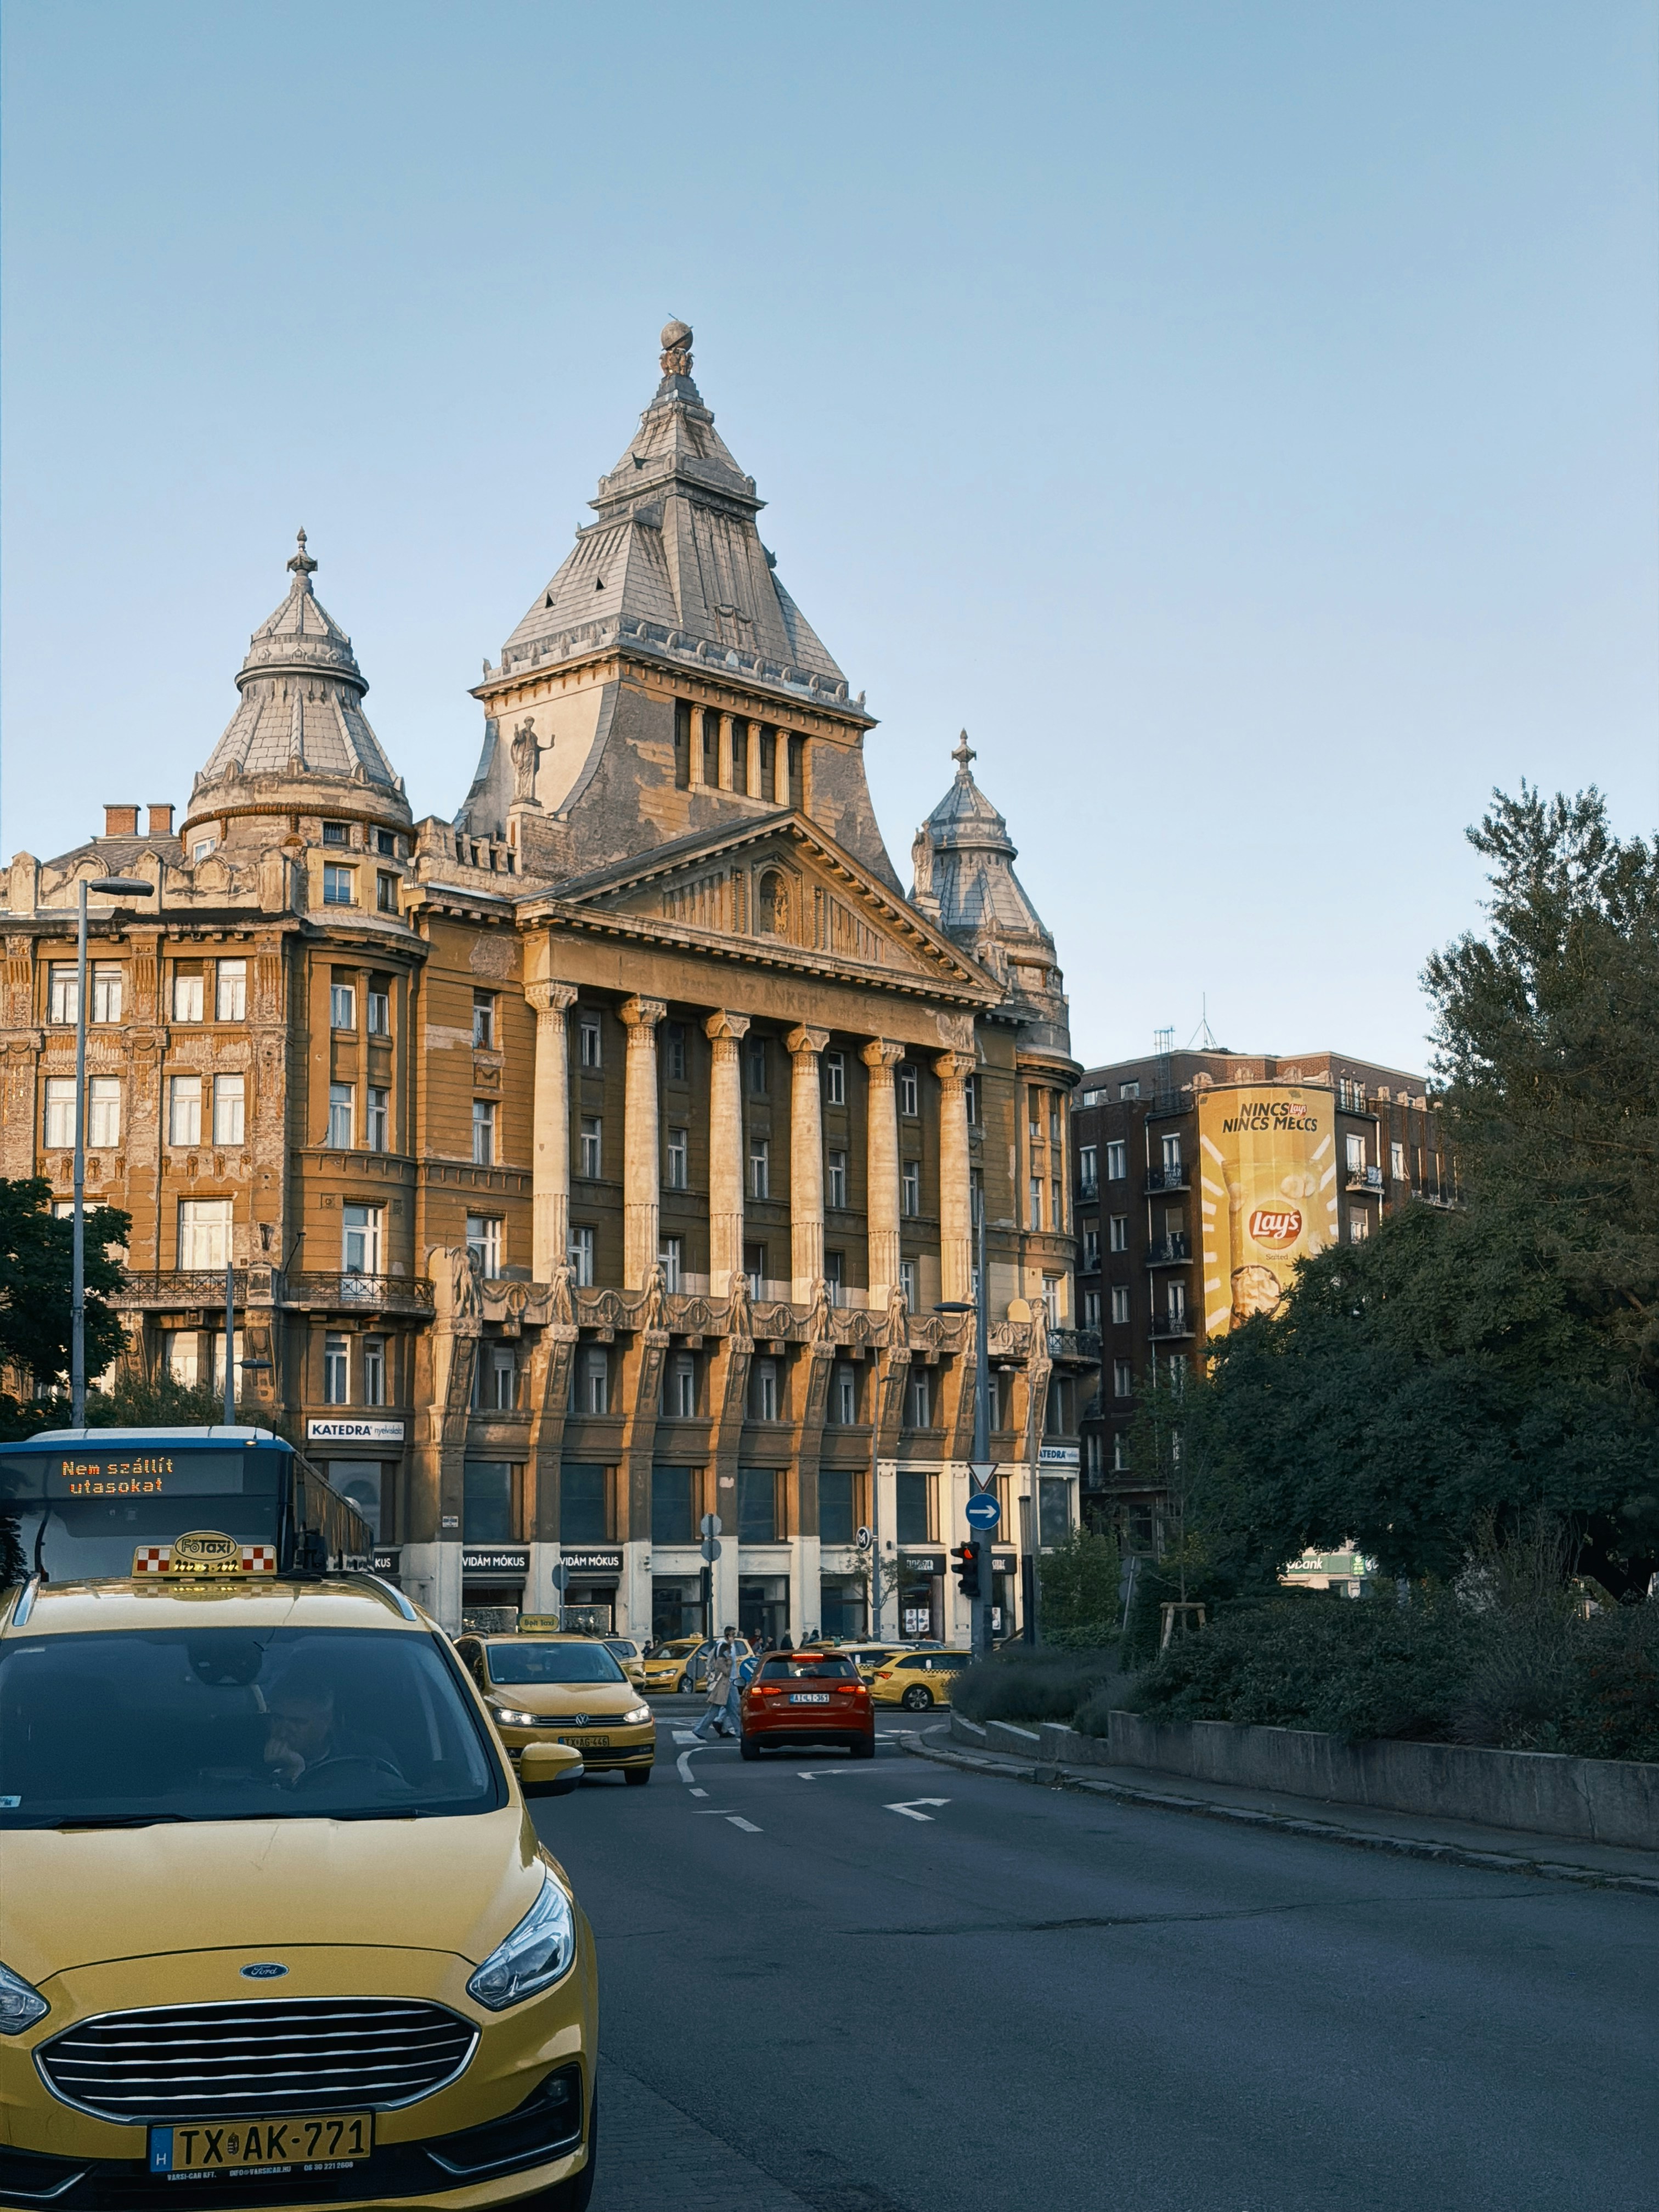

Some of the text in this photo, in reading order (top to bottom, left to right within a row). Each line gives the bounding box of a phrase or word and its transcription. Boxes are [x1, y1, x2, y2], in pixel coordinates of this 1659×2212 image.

[1240, 1102, 1289, 1117] NINCS
[1222, 1116, 1318, 1133] NINCS MECCS
[1252, 1211, 1300, 1239] Lay's
[312, 1424, 371, 1436] KATEDRA
[1040, 1449, 1066, 1459] ATEDRA
[62, 1457, 173, 1475] Nem szállít
[70, 1478, 162, 1494] utasokat
[375, 1558, 391, 1568] KUS
[462, 1554, 525, 1566] VIDÁM MÓKUS
[560, 1554, 619, 1566] VIDÁM MÓKUS
[251, 1966, 278, 1975] Ford
[179, 2128, 224, 2165] TX
[242, 2119, 365, 2160] AK-771
